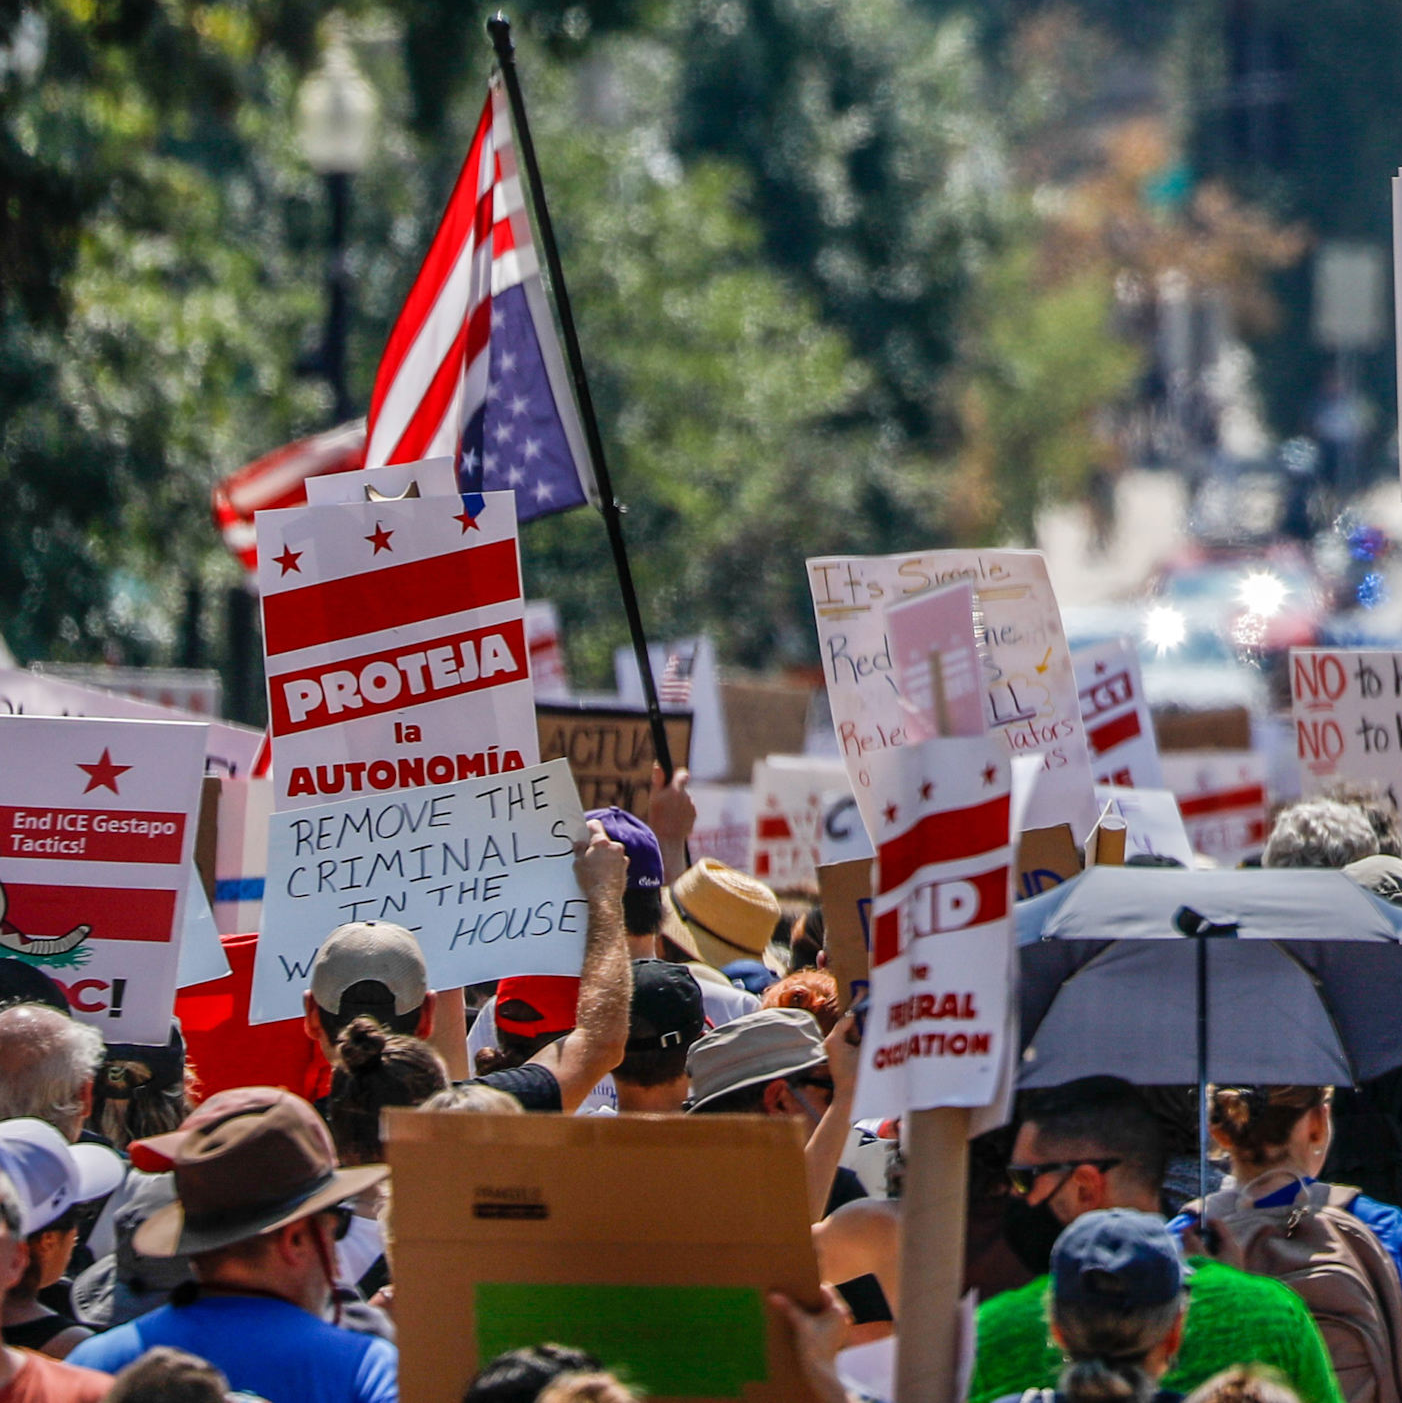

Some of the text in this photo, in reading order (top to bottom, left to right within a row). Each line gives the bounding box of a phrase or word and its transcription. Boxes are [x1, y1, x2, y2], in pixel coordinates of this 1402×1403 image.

[283, 633, 518, 723] PROTEJA
[1294, 654, 1347, 700] NO
[1355, 656, 1382, 698] to
[394, 722, 422, 744] la
[548, 724, 655, 771] ACTUA
[1004, 718, 1074, 750] lators
[1297, 720, 1345, 760] NO
[1357, 717, 1390, 754] to
[287, 746, 525, 797] AUTONOMÍA
[13, 812, 176, 838] End ICE Gestapo
[290, 794, 456, 857] REMOVE
[475, 775, 549, 821] THE
[11, 834, 86, 854] Tactics!
[287, 820, 574, 898] CRIMINALS
[338, 874, 509, 927] IN THE
[449, 900, 588, 951] HOUSE
[50, 978, 126, 1018] C!
